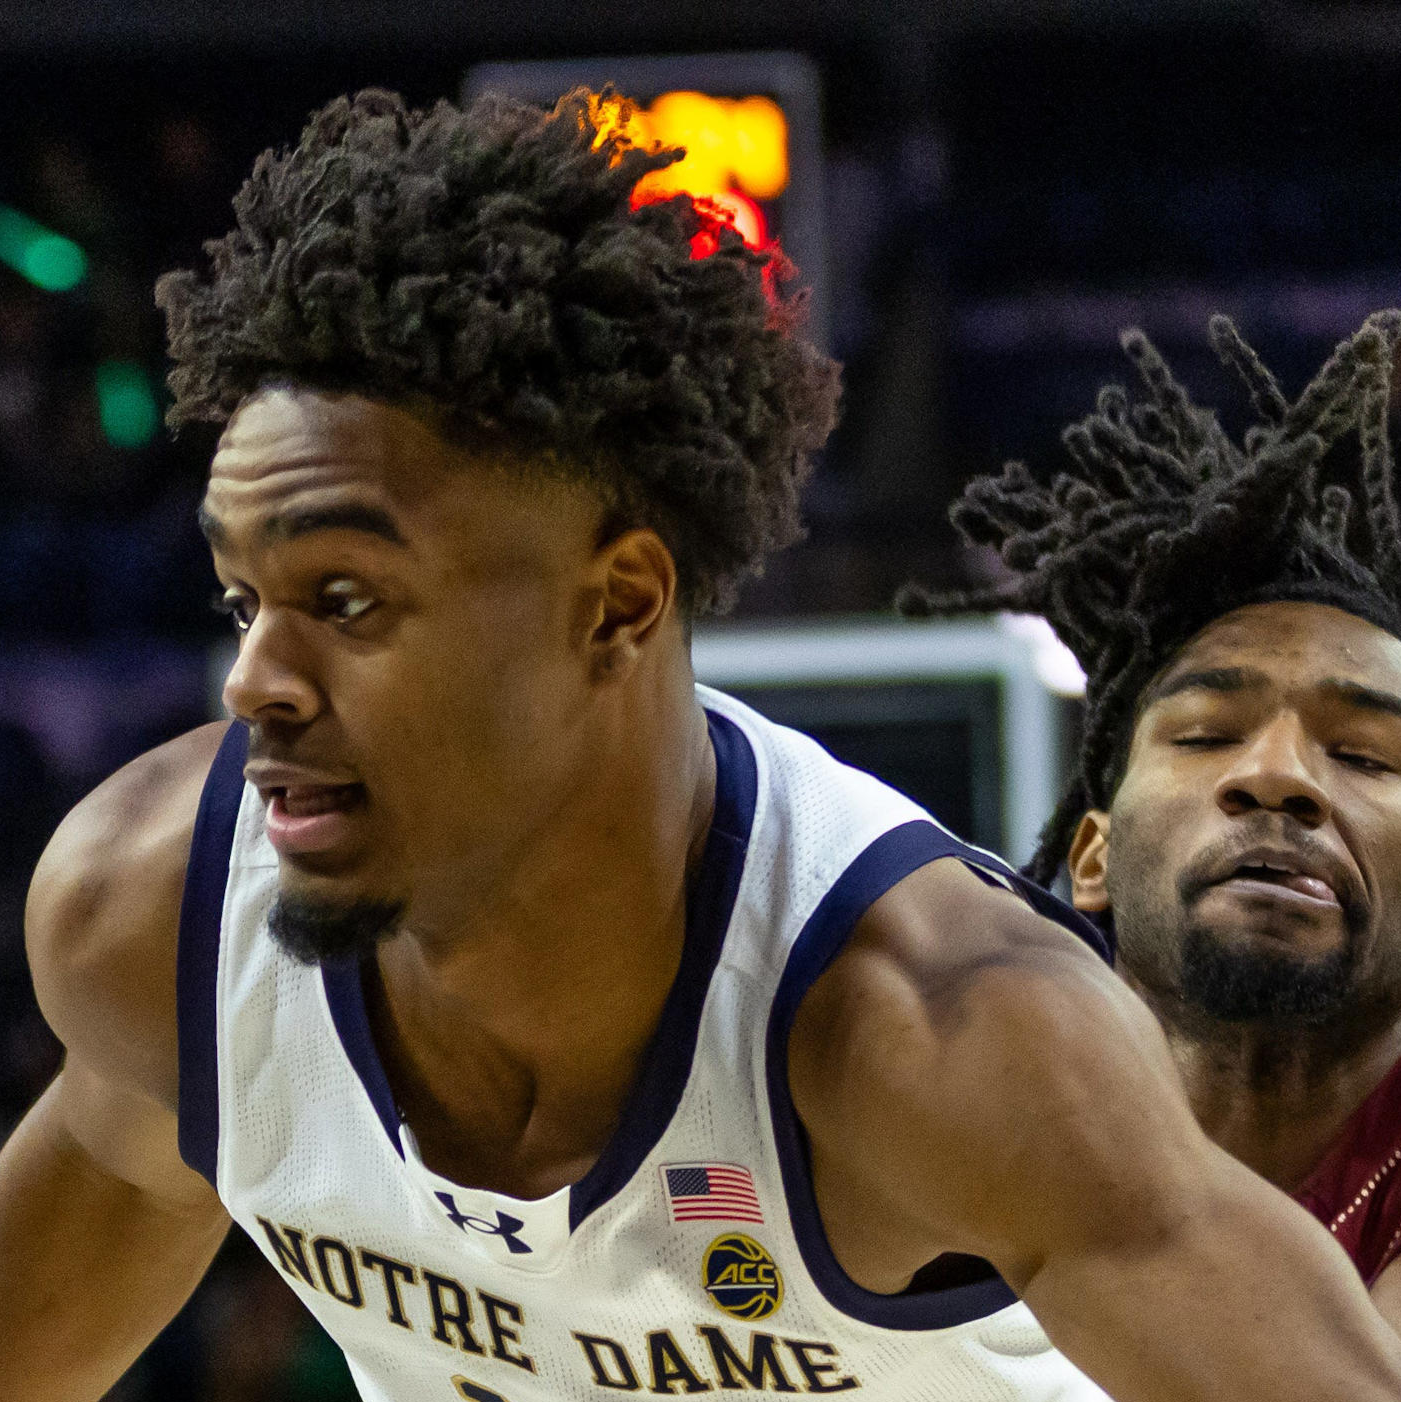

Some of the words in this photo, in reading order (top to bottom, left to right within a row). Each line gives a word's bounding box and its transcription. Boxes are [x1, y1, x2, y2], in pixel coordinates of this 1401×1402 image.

[254, 1215, 538, 1376] NOTRE
[571, 1323, 862, 1394] DAME
[712, 1263, 775, 1284] ACC
